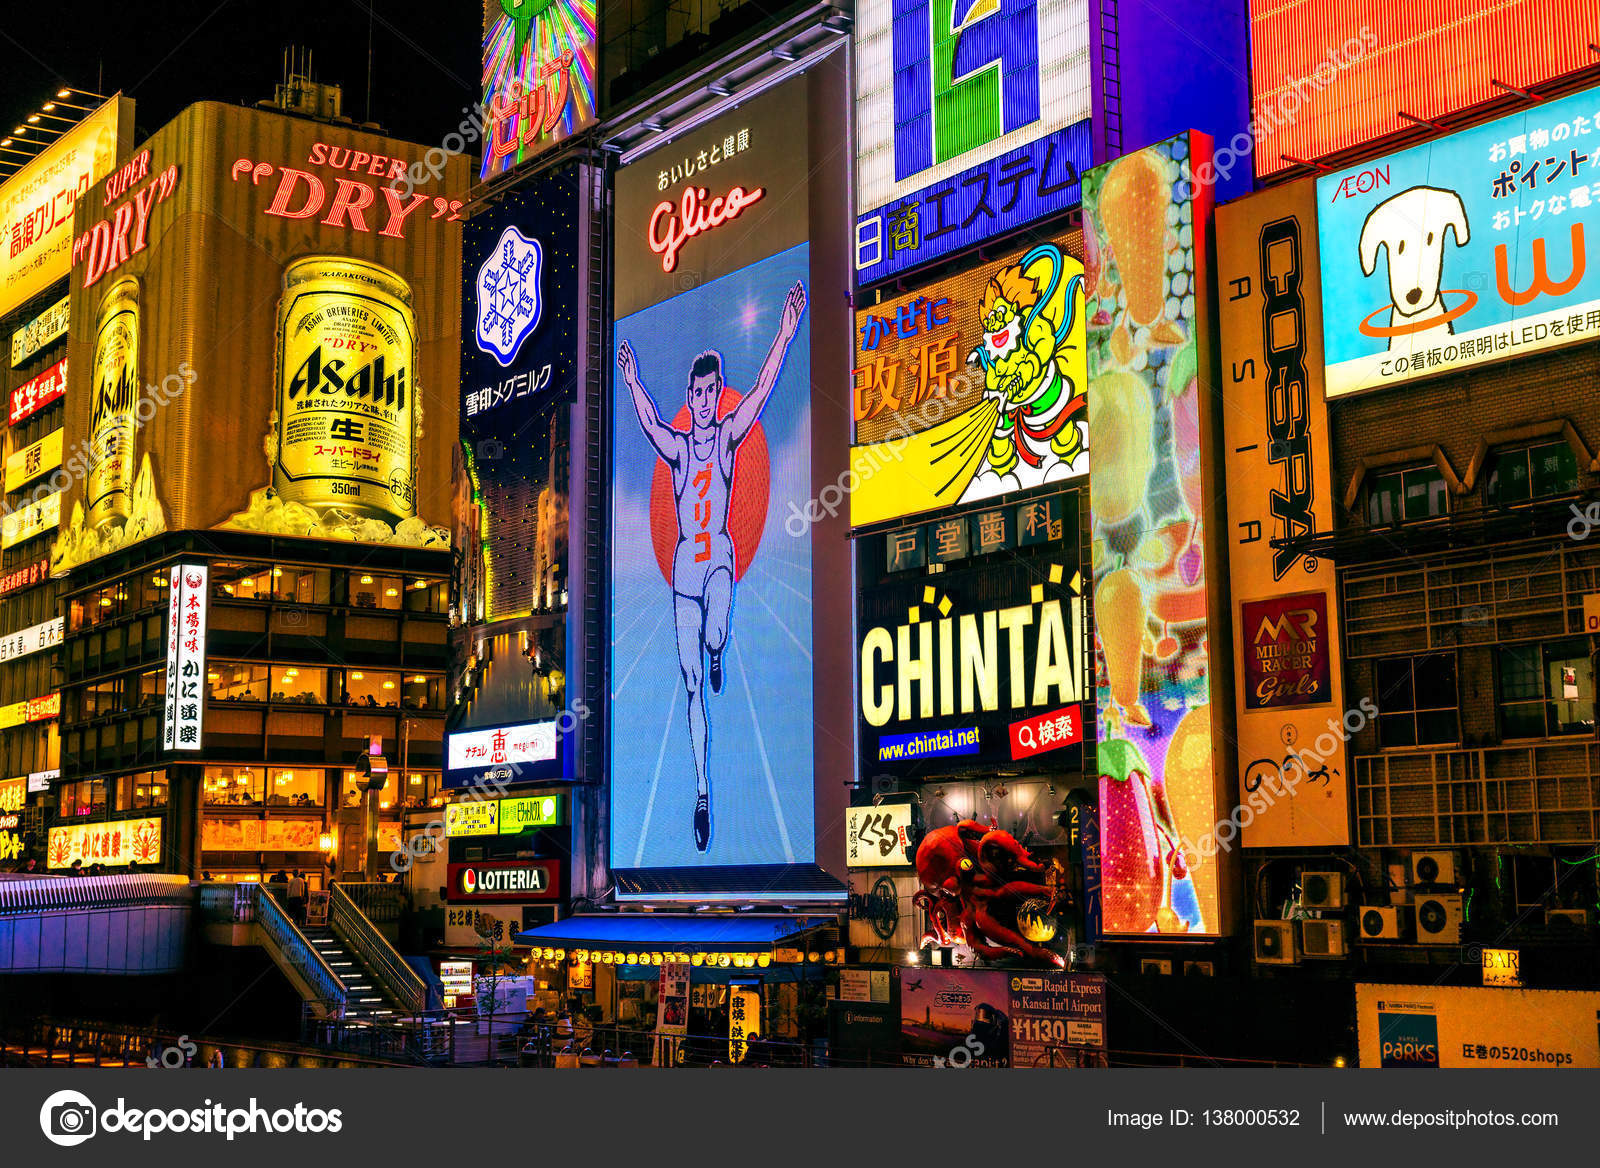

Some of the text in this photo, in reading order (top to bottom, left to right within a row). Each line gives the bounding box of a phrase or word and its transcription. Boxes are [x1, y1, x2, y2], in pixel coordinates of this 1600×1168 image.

[104, 149, 150, 207] SUPER
[307, 142, 408, 181] SUPER
[657, 128, 749, 191] おいしさと健康
[855, 142, 1078, 271] 日商エステム
[649, 186, 764, 273] Glico
[304, 313, 324, 333] ASAHI
[326, 306, 370, 322] BREWERIES
[371, 317, 395, 346] LIMITED
[860, 295, 950, 352] かぜに
[289, 345, 405, 411] Asahi
[465, 364, 552, 416] 雪印メグミルク
[852, 332, 961, 422] 改源
[92, 363, 135, 434] Asahi
[1228, 275, 1262, 545] ASIA
[330, 418, 365, 443] 生
[314, 445, 381, 463] スーパードライ
[331, 458, 361, 471] 生ビール
[331, 482, 361, 497] 350ml
[390, 477, 413, 505] お酒
[692, 462, 713, 563] グリコ
[184, 593, 200, 653] 本場の味
[861, 596, 1083, 728] CHINTAI
[1256, 639, 1317, 660] MILLION
[1262, 655, 1313, 673] RACER
[1256, 673, 1319, 705] Girls
[465, 729, 538, 764] ナチュレ 恵 megumi
[1038, 715, 1073, 746] 検索
[478, 869, 541, 890] LOTTERIA
[1483, 951, 1519, 969] BAR
[1012, 999, 1020, 1008] to
[1022, 996, 1050, 1010] Kansai
[1071, 999, 1102, 1016] Airport
[1044, 979, 1068, 996] Rapid
[1070, 980, 1101, 998] Express
[1462, 1043, 1573, 1066] 圧巻の520shops
